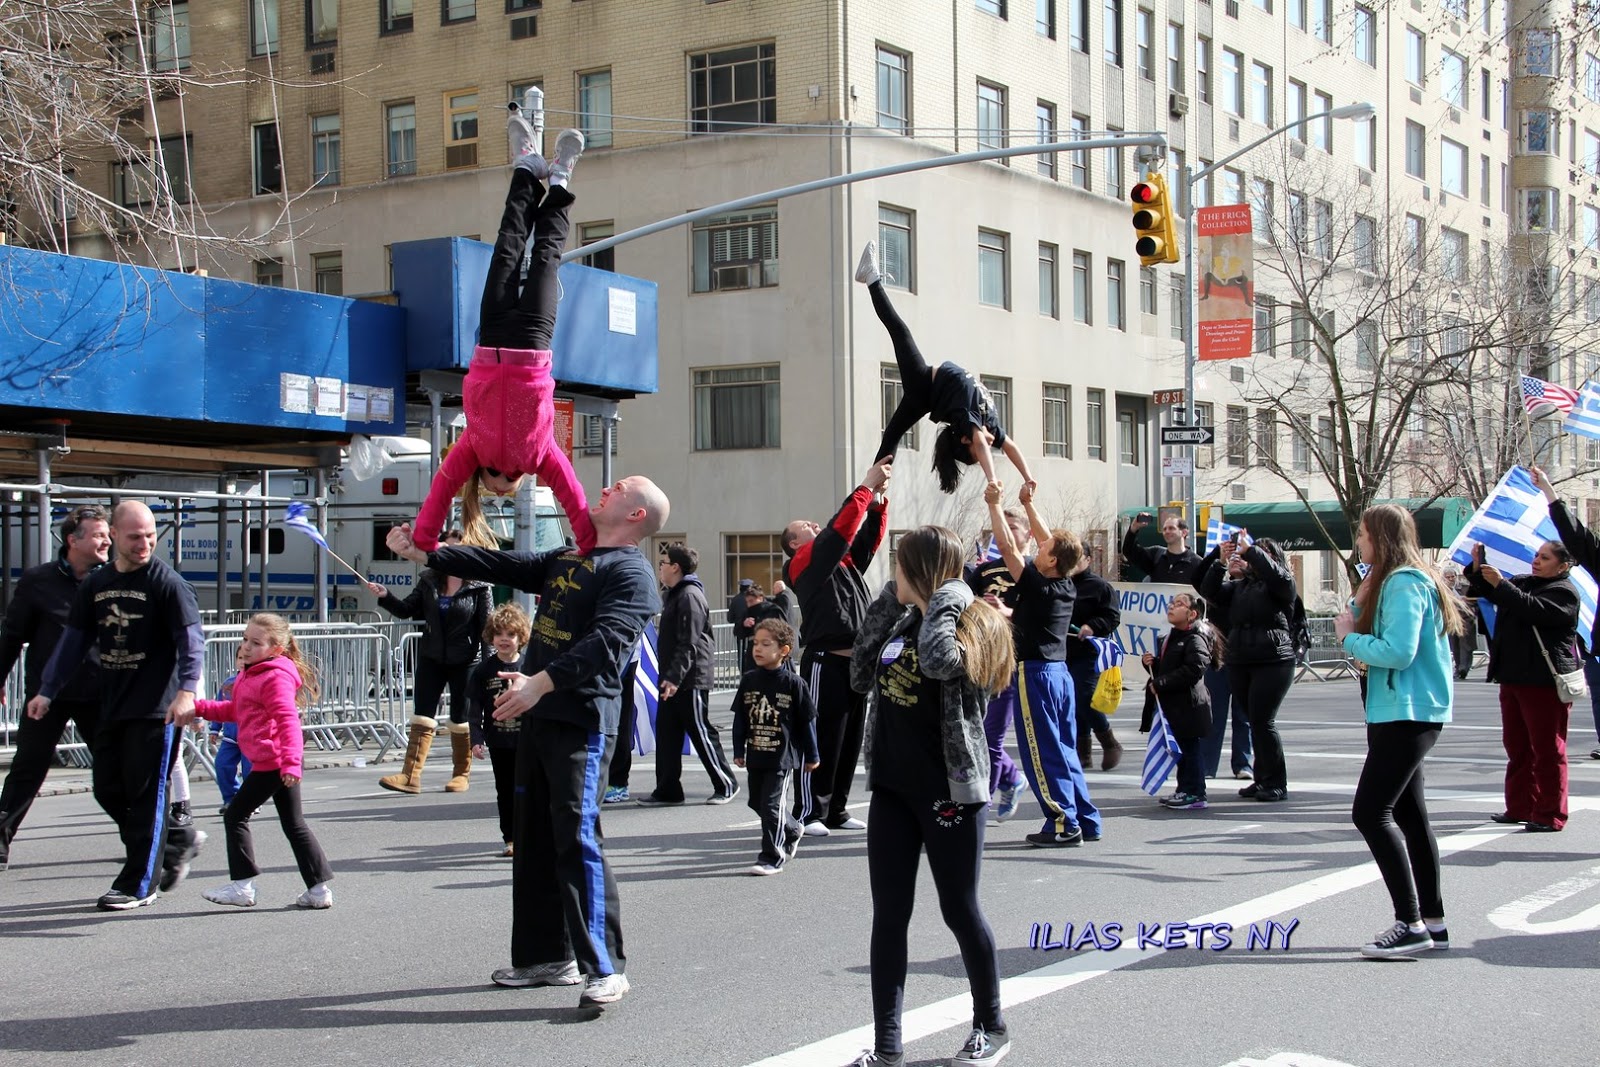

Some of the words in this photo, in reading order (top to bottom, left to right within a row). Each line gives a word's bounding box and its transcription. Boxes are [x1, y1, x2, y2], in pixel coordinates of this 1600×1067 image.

[1202, 212, 1220, 221] THE
[1221, 210, 1248, 220] FRICK
[1201, 219, 1248, 230] COLLECTION
[1153, 393, 1159, 404] E
[1161, 392, 1170, 404] 69
[1172, 391, 1180, 403] ST
[1168, 432, 1183, 440] ONE
[1190, 432, 1206, 440] WAY
[198, 539, 233, 549] BOROH
[1293, 536, 1315, 547] Five
[367, 573, 413, 586] POLICE
[1116, 589, 1174, 615] MPION
[935, 816, 953, 828] SURF
